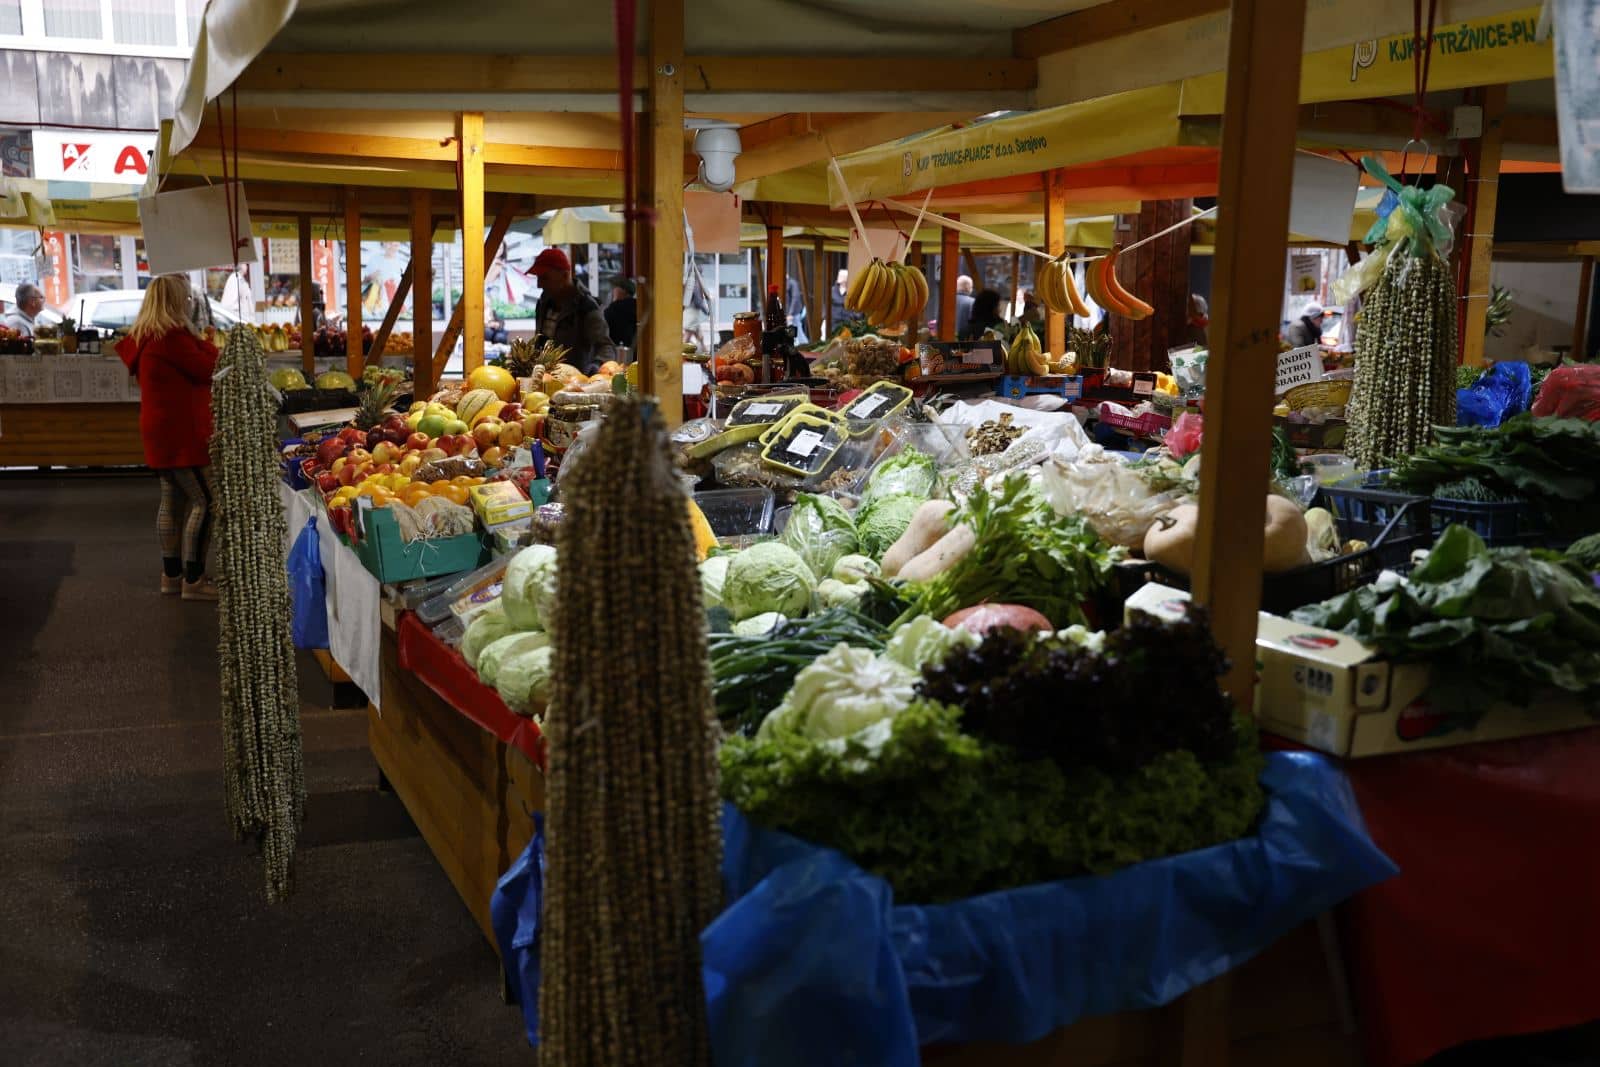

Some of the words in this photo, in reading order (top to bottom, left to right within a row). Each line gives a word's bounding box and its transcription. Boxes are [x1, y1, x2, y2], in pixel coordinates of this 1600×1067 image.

[1432, 17, 1552, 55] "TRŽNICE-PIJ
[1015, 135, 1047, 154] Sarajevo
[114, 145, 153, 175] A
[1275, 351, 1312, 368] ANDER
